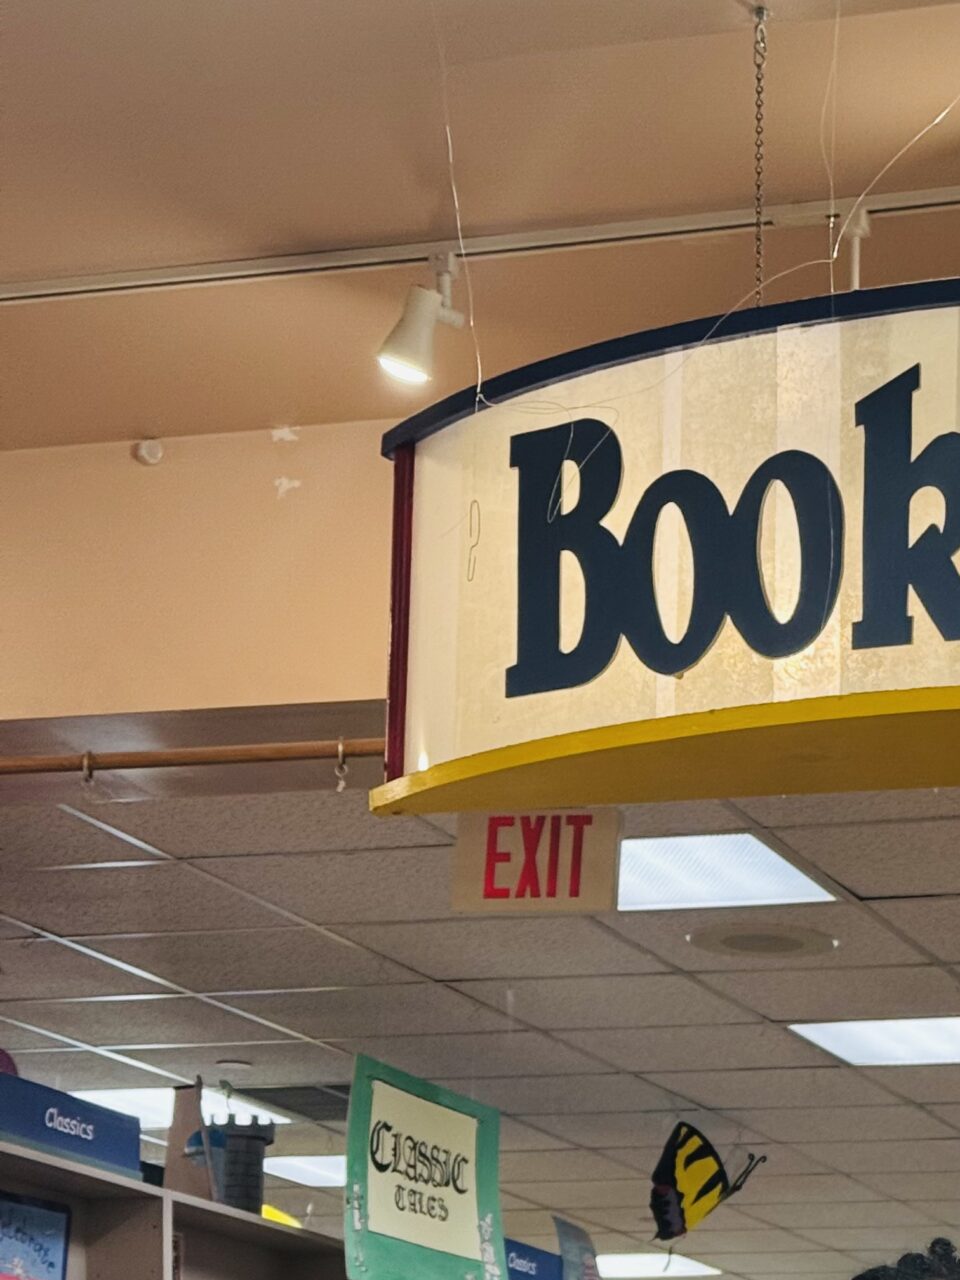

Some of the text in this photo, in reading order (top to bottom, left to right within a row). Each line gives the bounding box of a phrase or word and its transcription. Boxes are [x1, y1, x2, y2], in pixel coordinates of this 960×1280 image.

[483, 814, 593, 898] EXIT
[45, 1107, 94, 1141] Classics
[370, 1120, 469, 1195] CLASSIC
[394, 1184, 449, 1222] TALES
[507, 1252, 537, 1276] Classics
